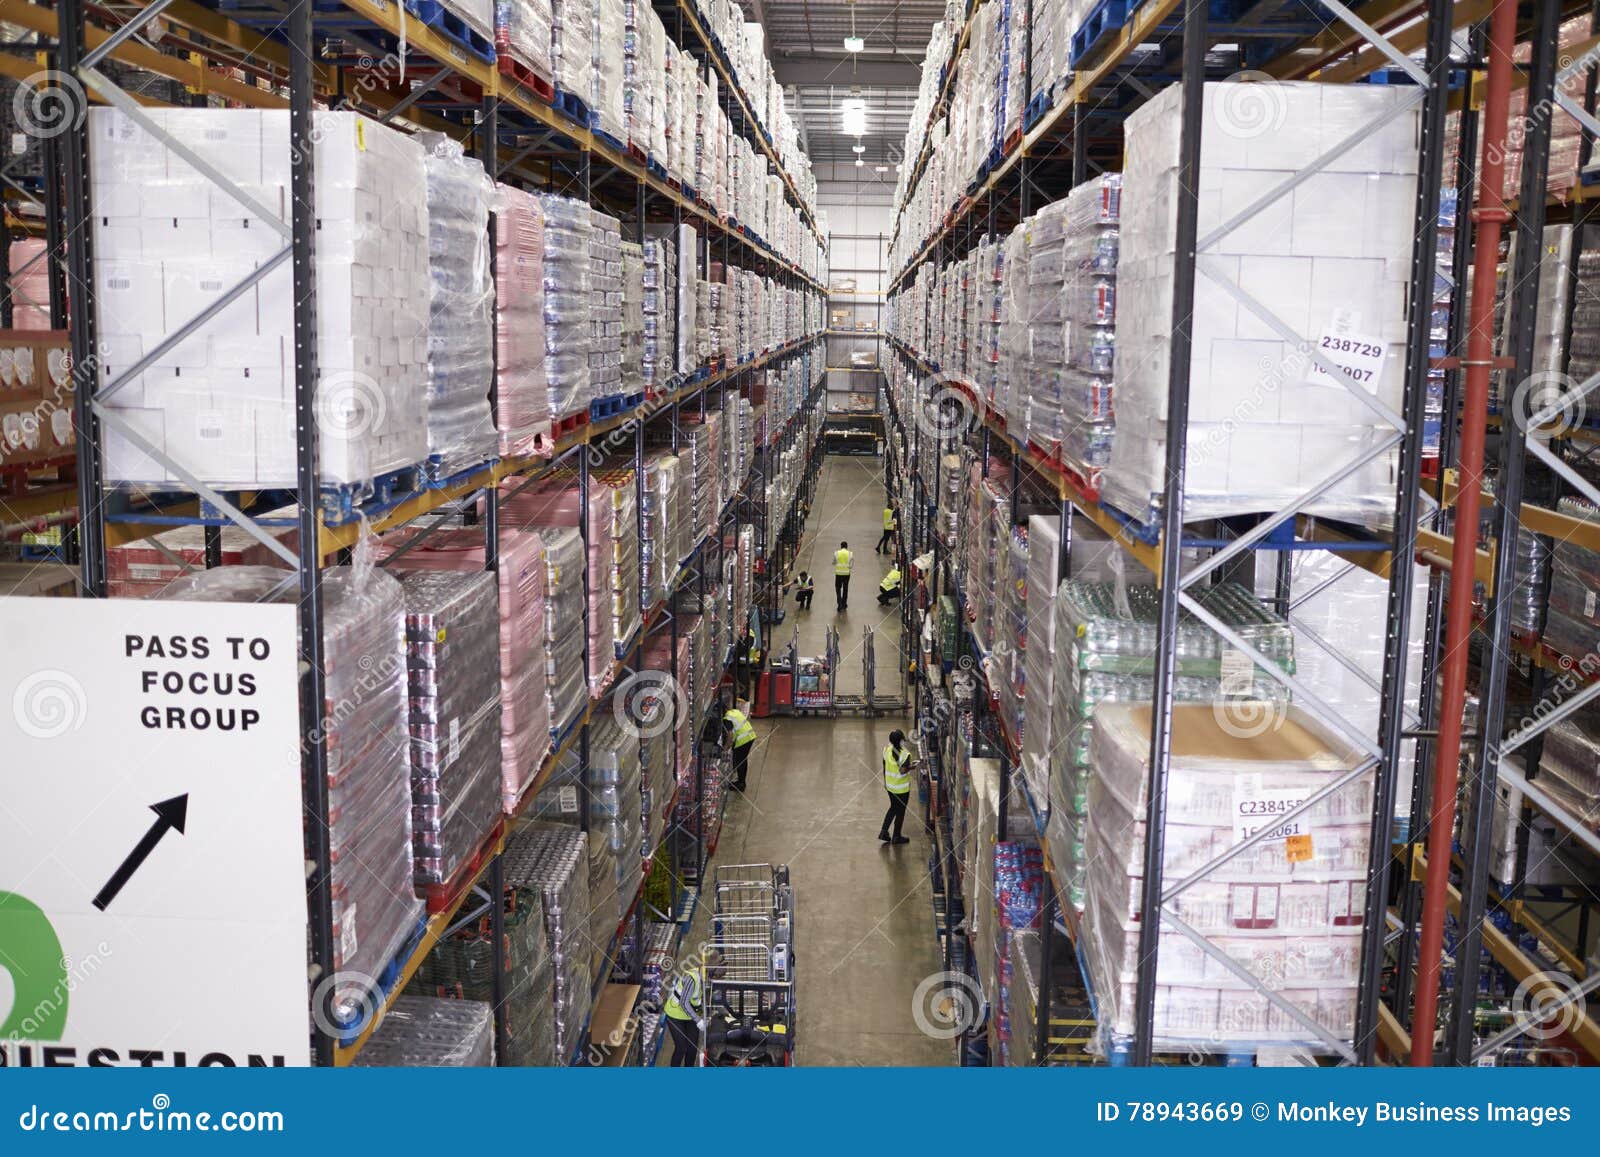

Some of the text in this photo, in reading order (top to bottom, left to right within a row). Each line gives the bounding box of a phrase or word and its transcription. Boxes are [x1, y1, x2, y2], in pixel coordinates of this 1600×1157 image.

[1322, 335, 1382, 358] 238729
[1313, 360, 1374, 382] 1907
[126, 635, 269, 660] PASS TO
[142, 671, 256, 695] FOCUS
[141, 707, 259, 730] GROUP
[1242, 823, 1300, 841] 16061
